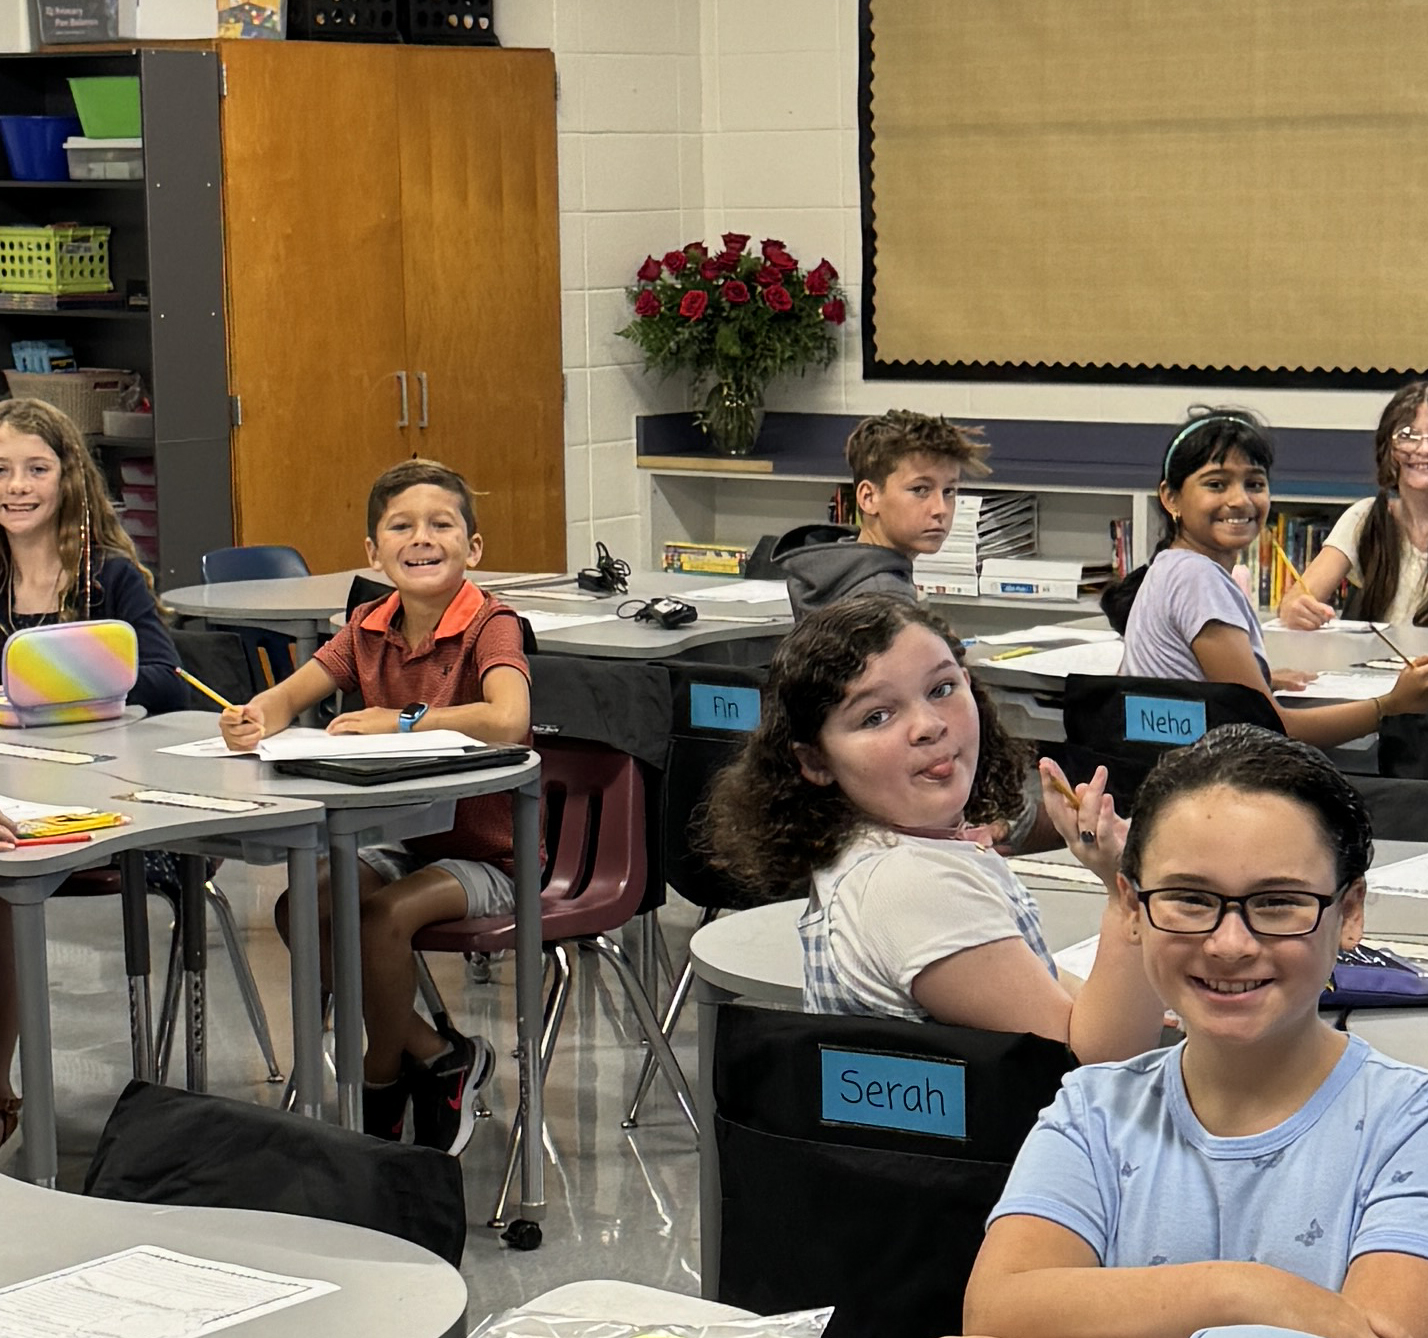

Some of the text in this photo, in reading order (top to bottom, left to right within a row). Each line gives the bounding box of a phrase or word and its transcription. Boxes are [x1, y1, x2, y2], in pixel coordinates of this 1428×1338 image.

[714, 696, 739, 718] Fin
[1140, 709, 1192, 736] Neha
[840, 1069, 946, 1117] Serah
